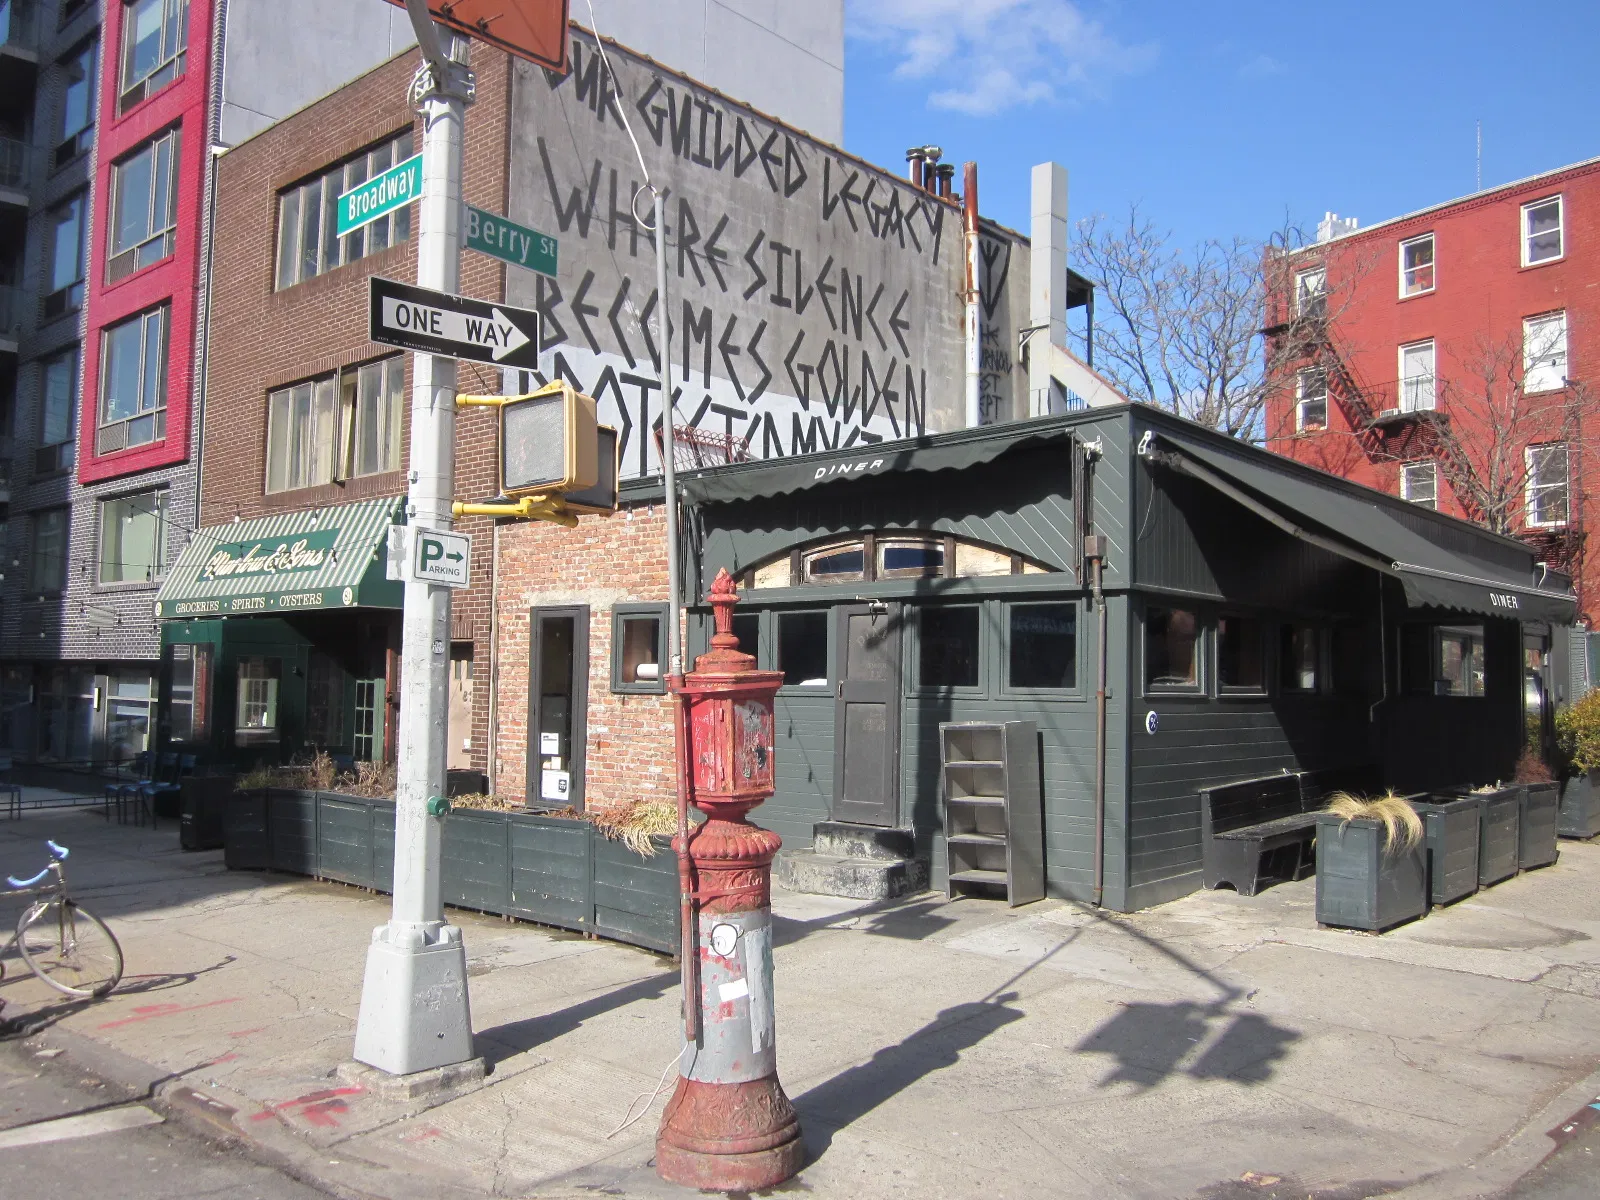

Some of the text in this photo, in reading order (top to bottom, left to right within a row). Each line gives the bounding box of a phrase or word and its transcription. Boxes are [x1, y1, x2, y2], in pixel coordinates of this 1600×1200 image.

[348, 166, 416, 221] Broadway
[636, 77, 808, 198] GUILDED
[823, 156, 945, 266] LEGACY
[467, 209, 555, 264] Berry St
[537, 136, 910, 359] WHERE SILENCE
[395, 303, 513, 348] ONE WAY
[536, 269, 926, 439] BECOMES GOLDEN
[814, 459, 884, 480] DINER
[203, 539, 325, 578] Marlow & Sons
[175, 600, 220, 614] GROCERIES
[231, 597, 266, 610] SPIRITS
[279, 592, 323, 607] OYSTERS
[1489, 592, 1519, 609] DINER
